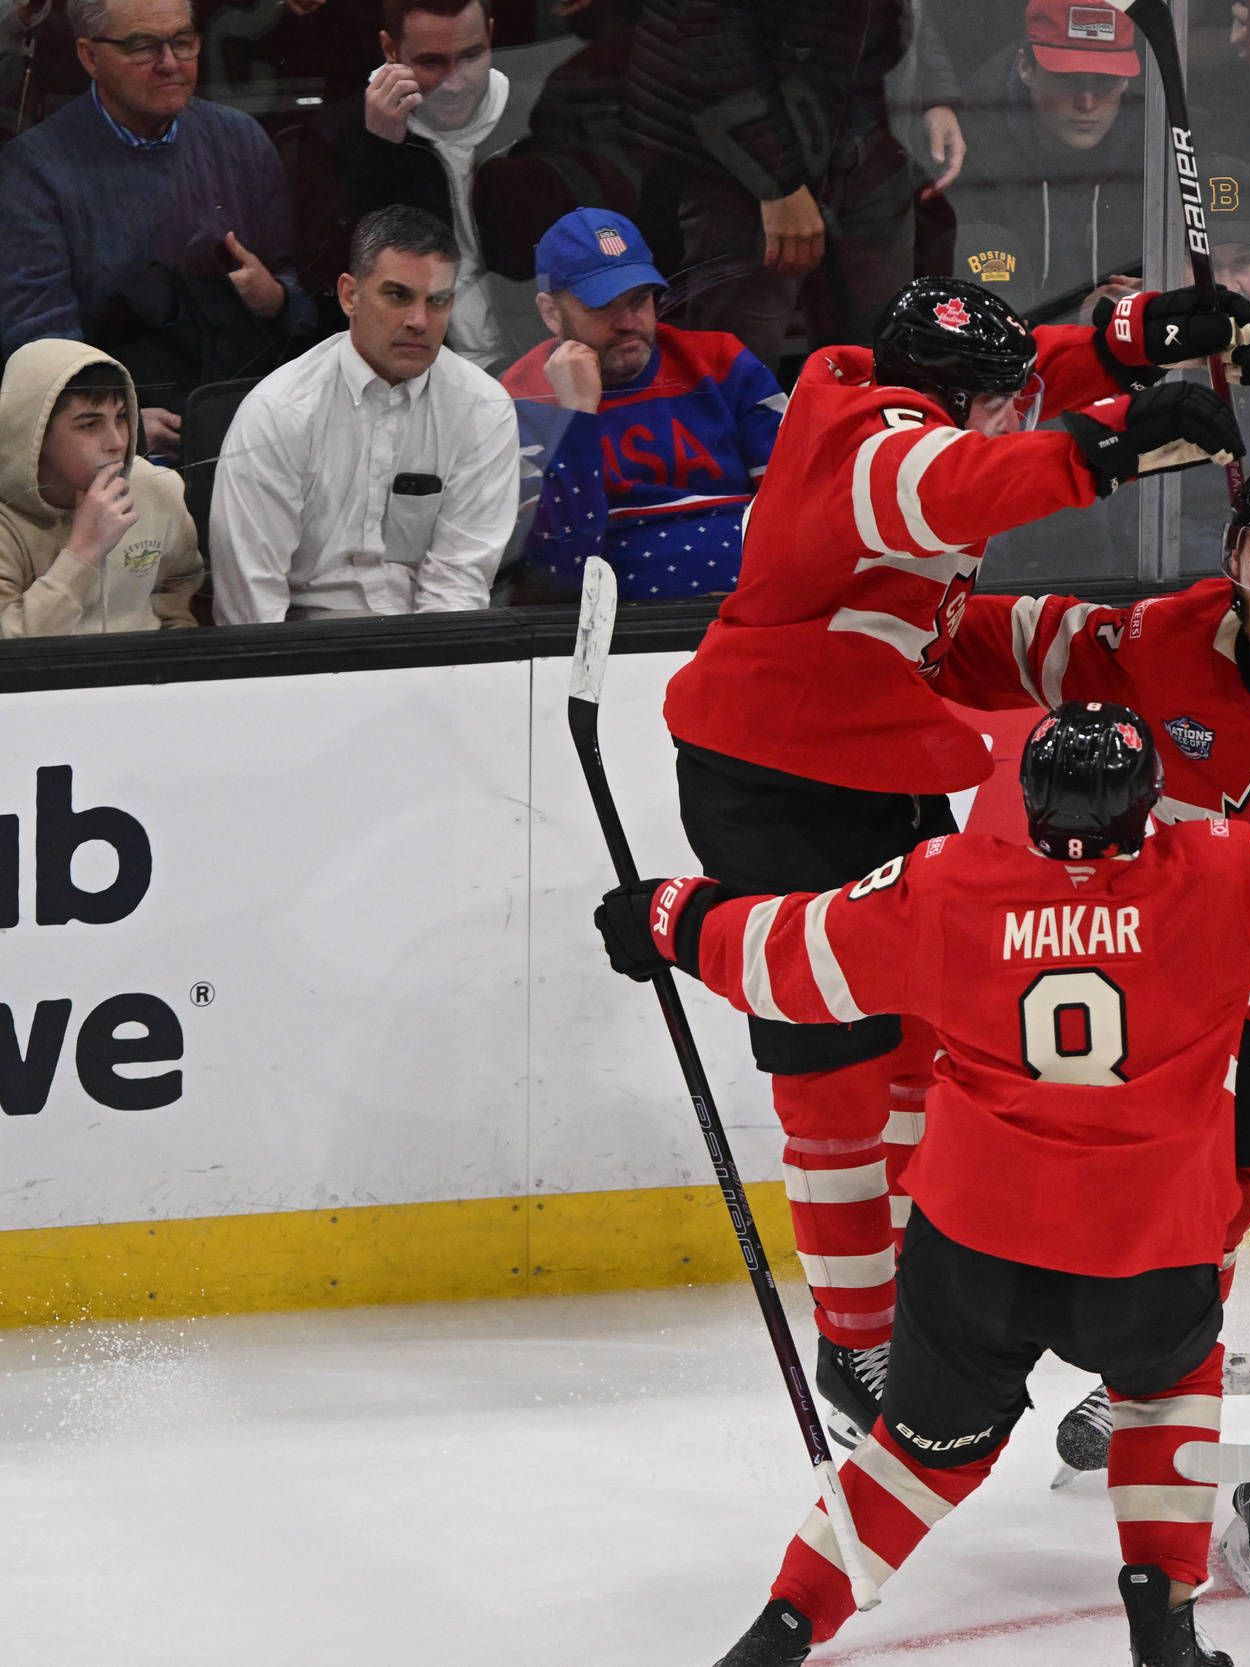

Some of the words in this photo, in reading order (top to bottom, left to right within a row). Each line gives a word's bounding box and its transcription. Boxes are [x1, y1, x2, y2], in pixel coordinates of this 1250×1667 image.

[1172, 126, 1210, 256] BAUER
[1208, 176, 1239, 212] B
[968, 250, 1015, 273] BOSTON
[600, 418, 724, 494] USA
[1068, 838, 1083, 859] 8
[847, 855, 905, 901] 8
[1003, 905, 1142, 960] MAKAR
[1018, 966, 1132, 1087] 8
[895, 1422, 994, 1451] BAUER
